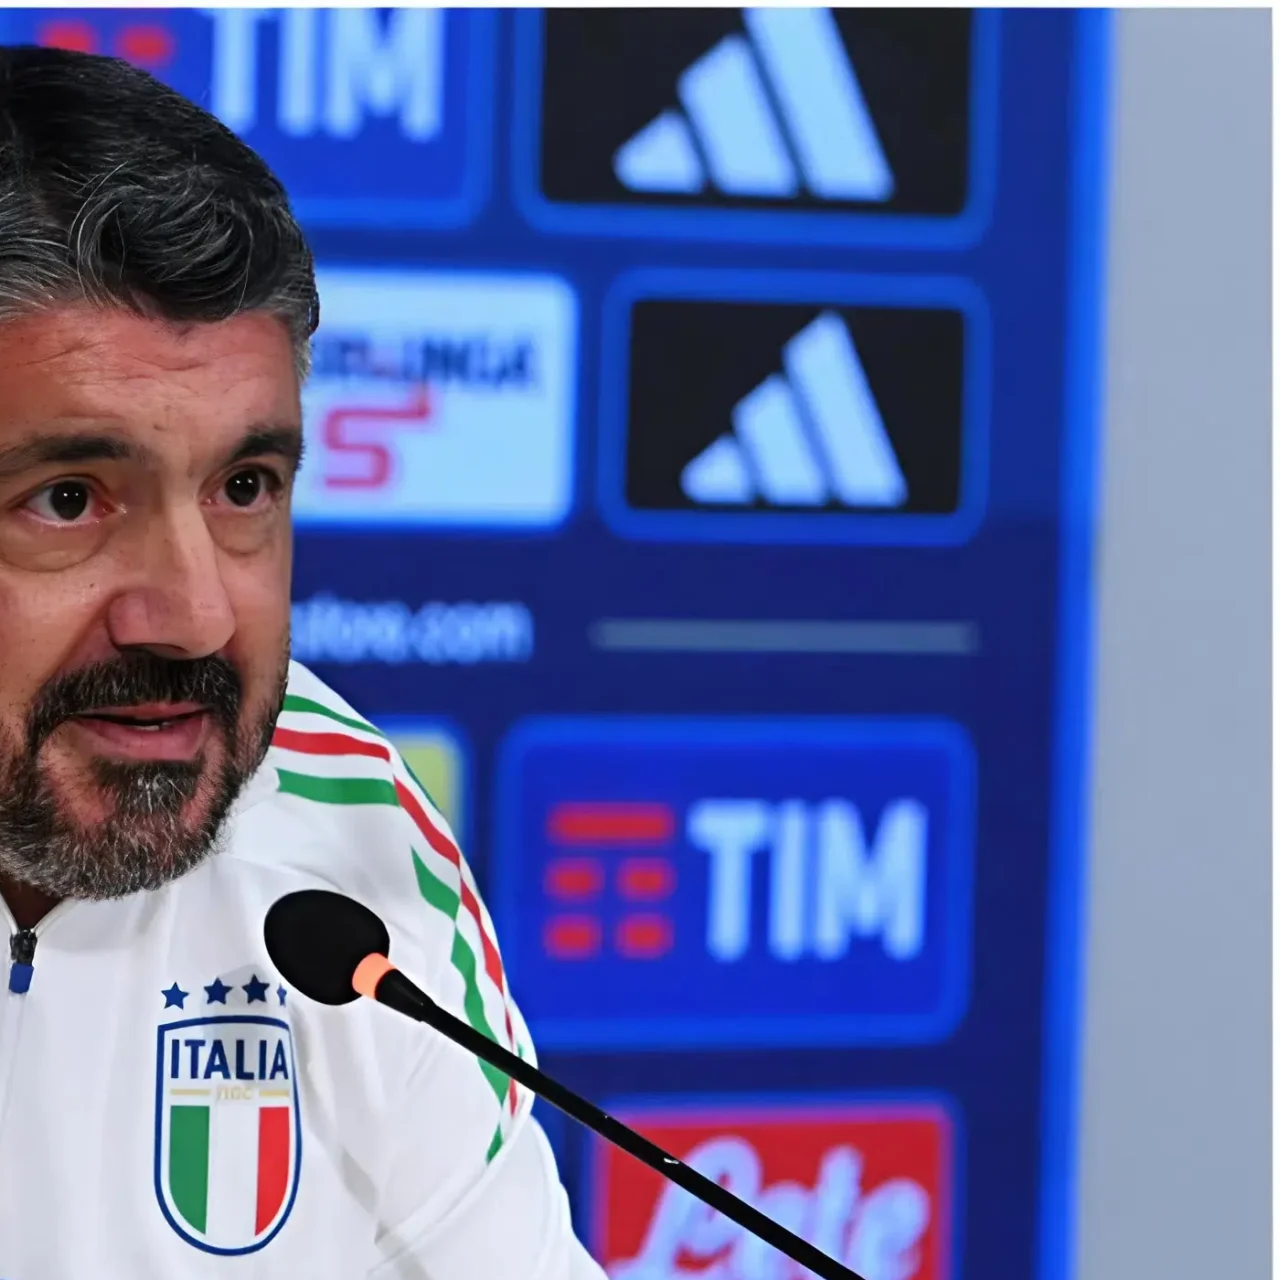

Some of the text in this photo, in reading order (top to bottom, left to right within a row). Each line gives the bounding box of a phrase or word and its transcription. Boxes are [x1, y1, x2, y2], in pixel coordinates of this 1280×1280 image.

[196, 8, 444, 141] TIM
[687, 797, 926, 962] TIM
[170, 1038, 290, 1081] ITALIA
